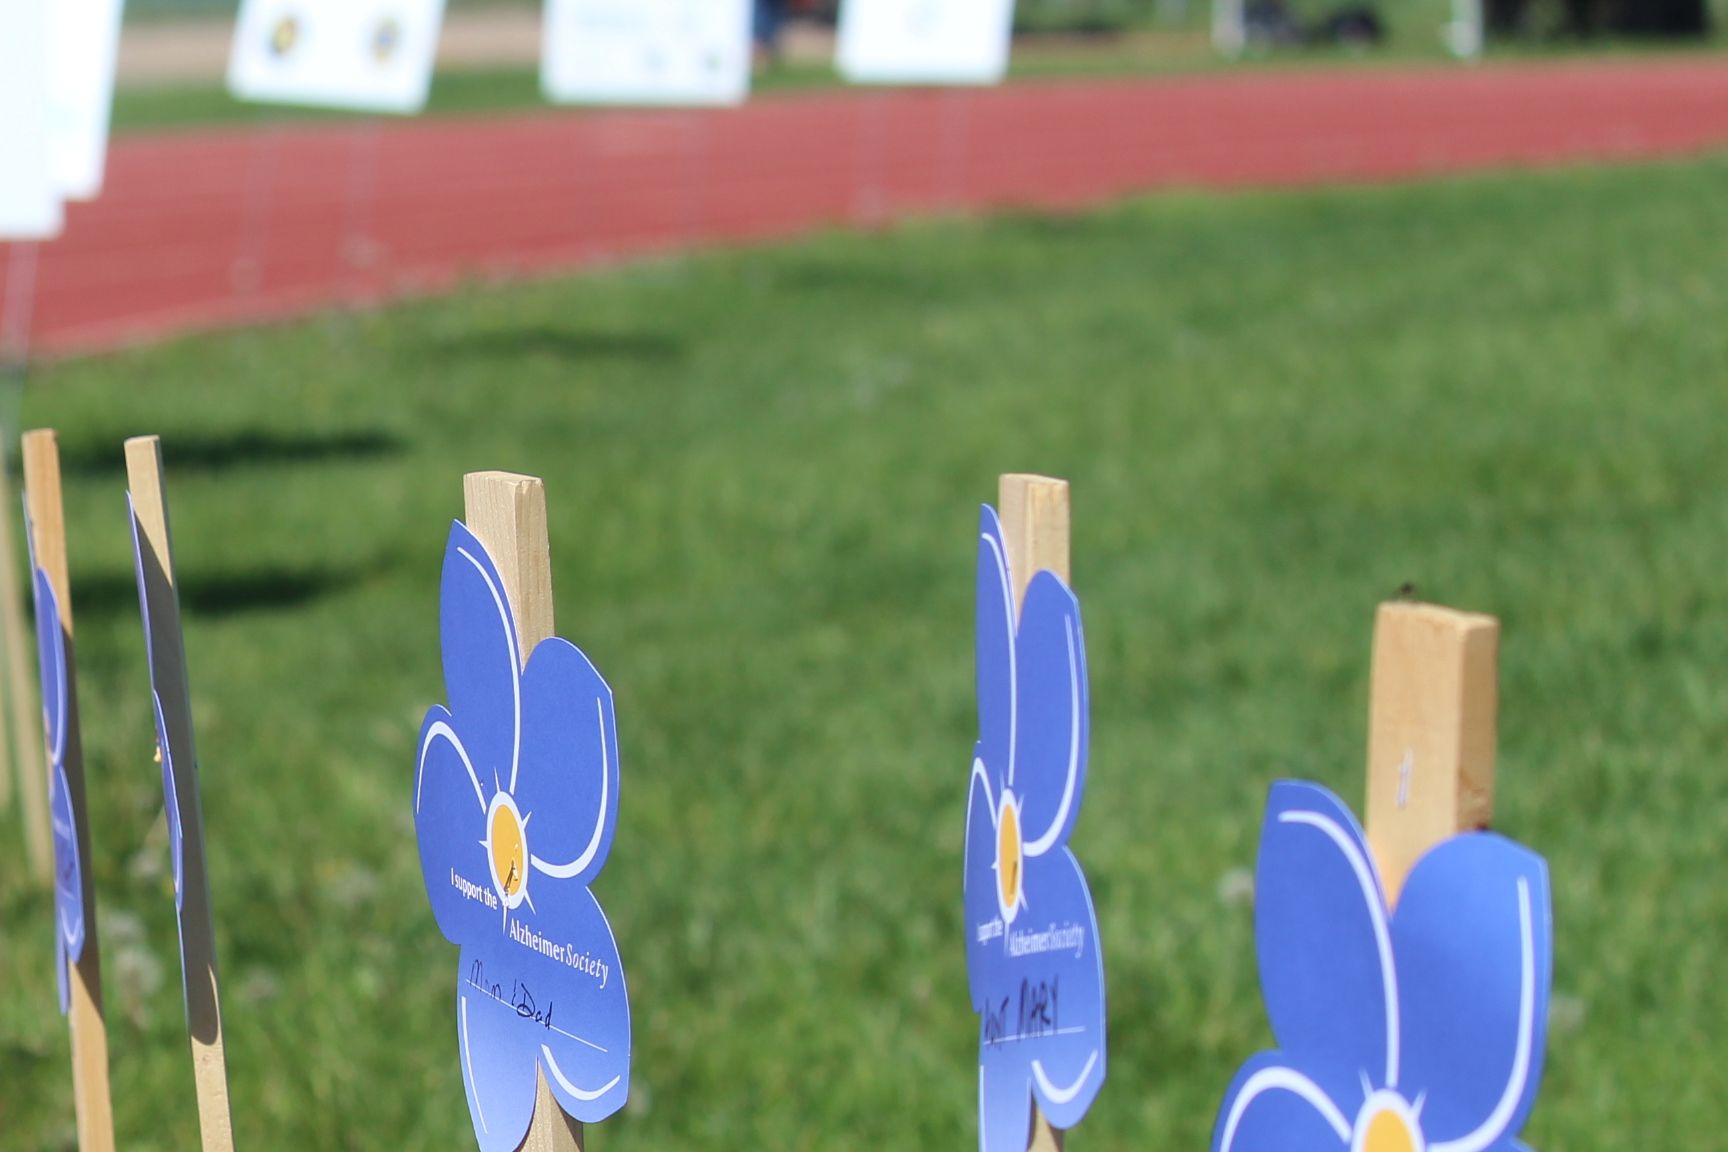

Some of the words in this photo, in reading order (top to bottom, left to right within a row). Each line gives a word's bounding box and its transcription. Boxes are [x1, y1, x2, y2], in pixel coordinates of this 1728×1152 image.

[450, 867, 454, 886] I
[455, 873, 483, 902] support
[483, 887, 498, 911] the
[516, 982, 553, 1031] Dad
